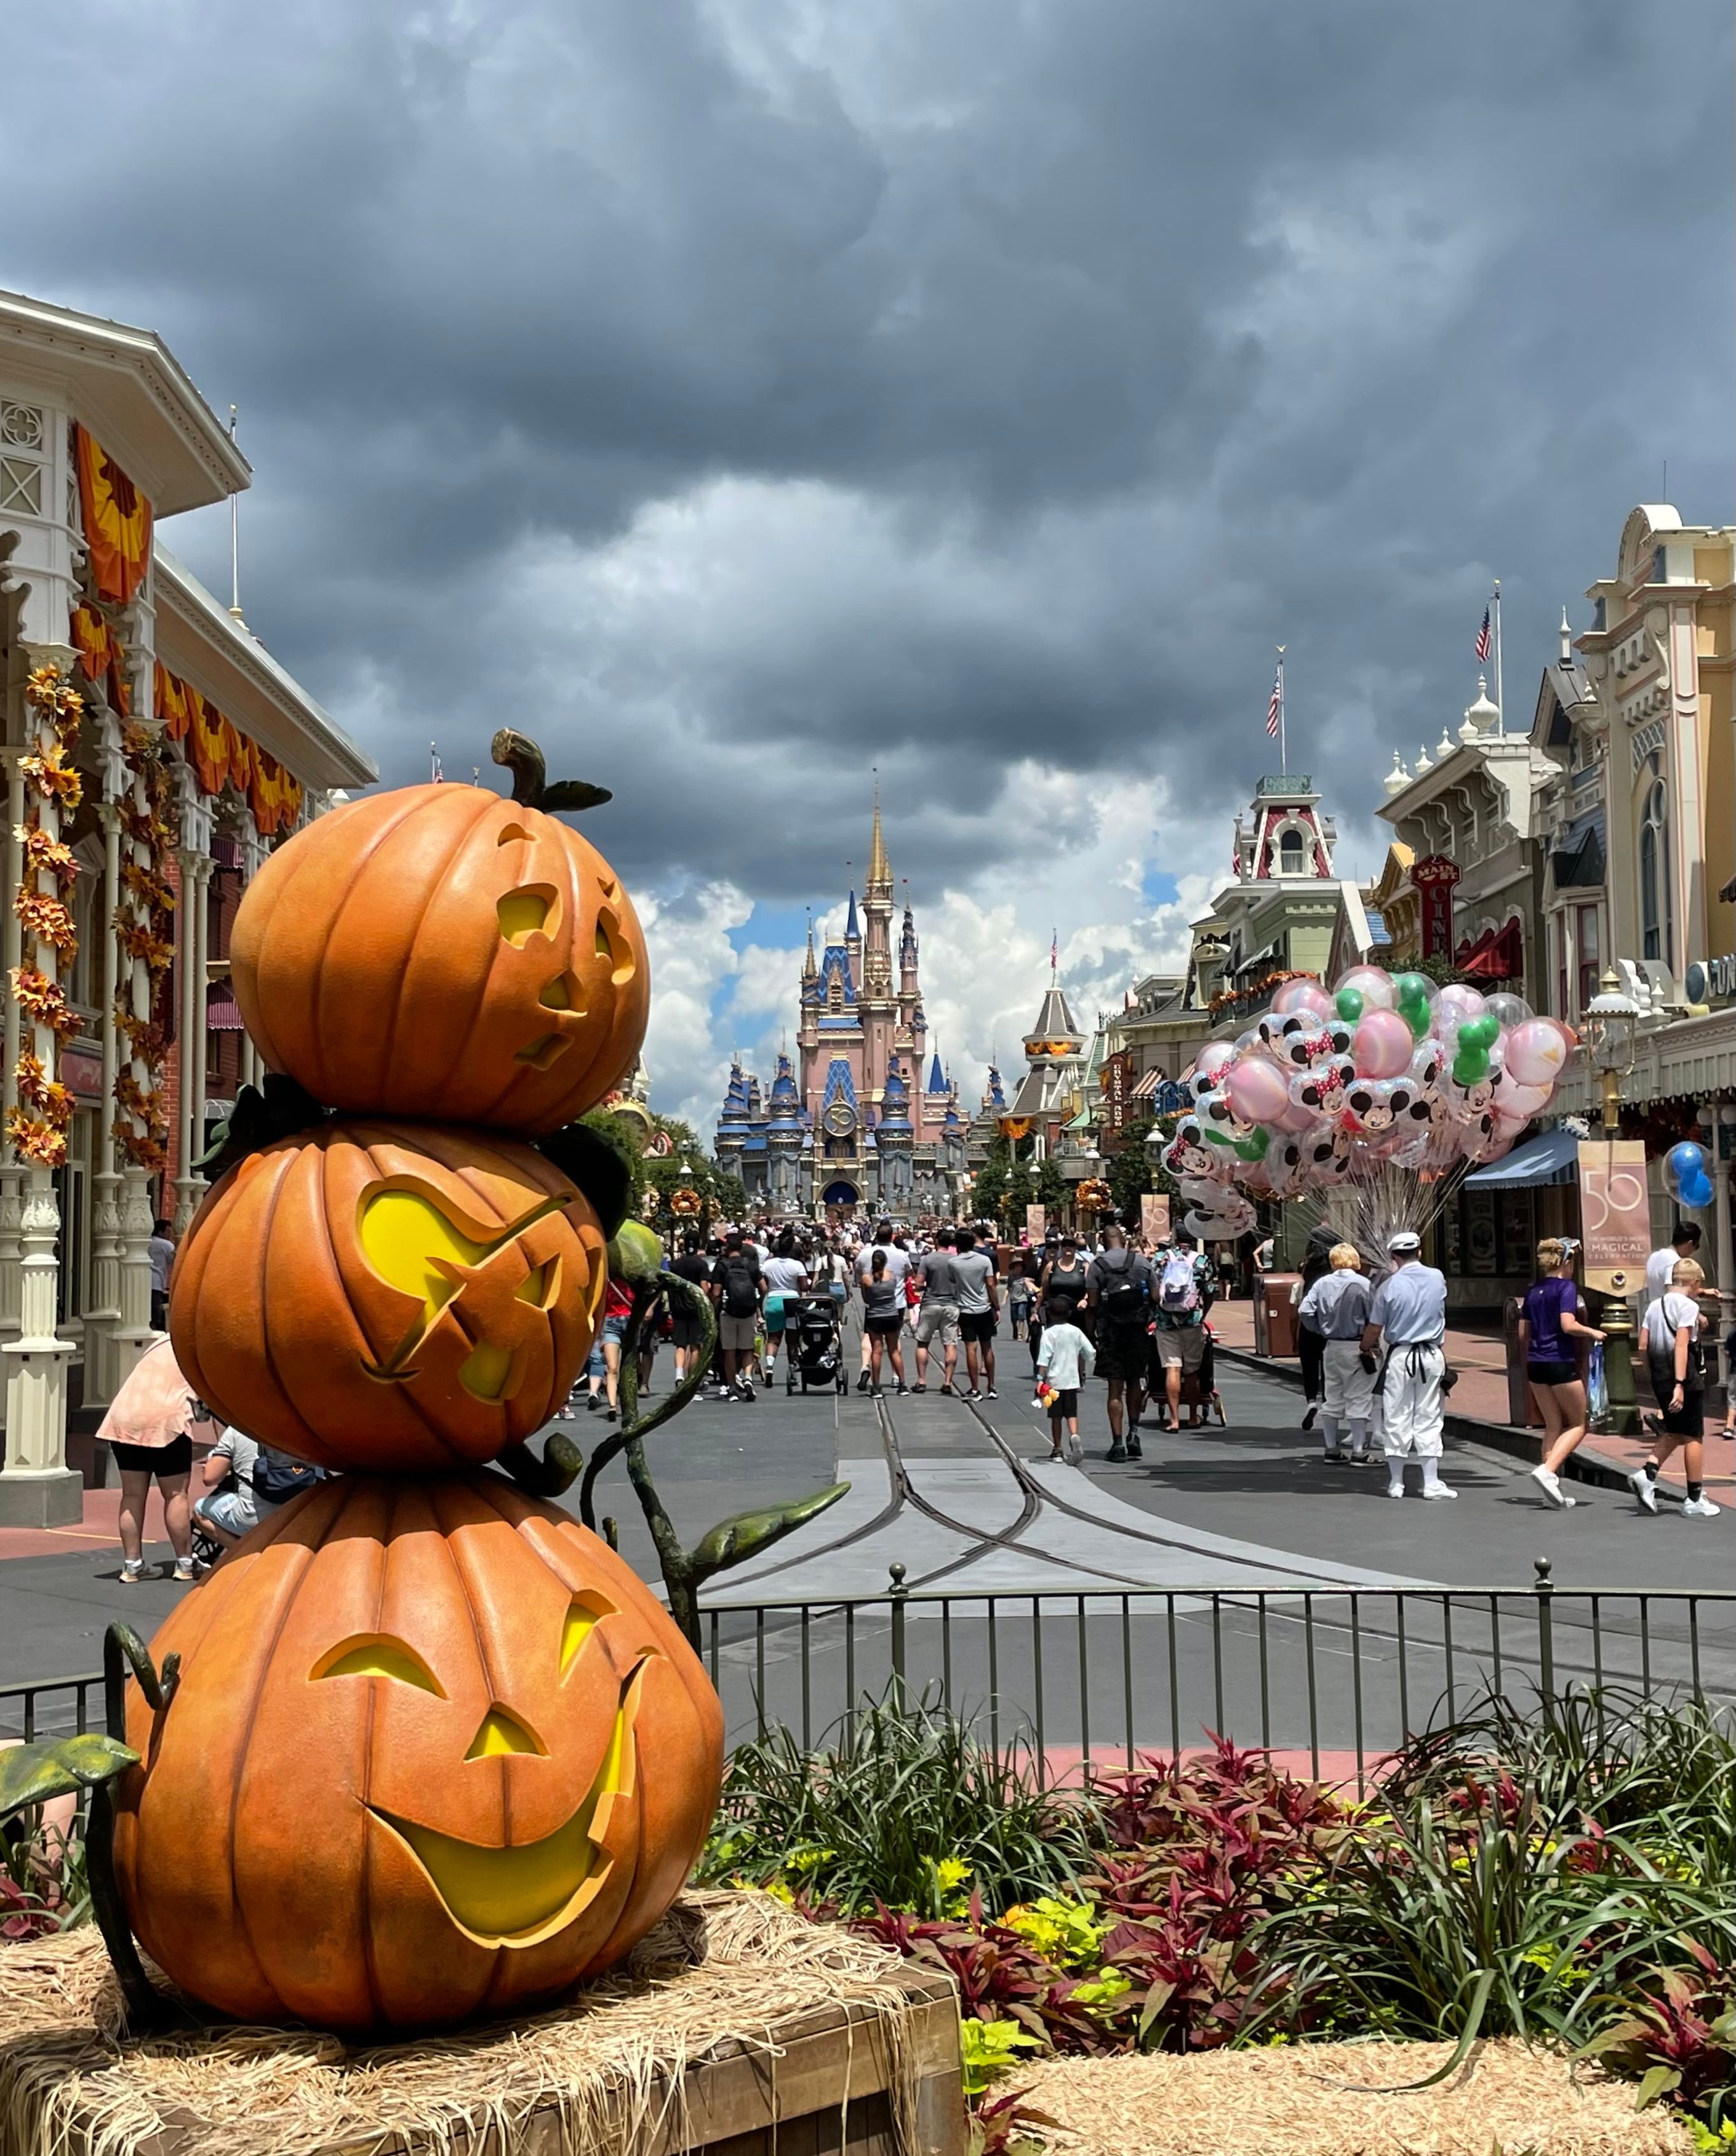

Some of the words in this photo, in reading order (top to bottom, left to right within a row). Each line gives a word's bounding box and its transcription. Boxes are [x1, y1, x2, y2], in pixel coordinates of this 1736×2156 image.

[1418, 865, 1454, 879] MAIN
[1585, 1171, 1642, 1230] 50
[1143, 1207, 1168, 1232] 50
[1592, 1243, 1643, 1252] MAGICAL
